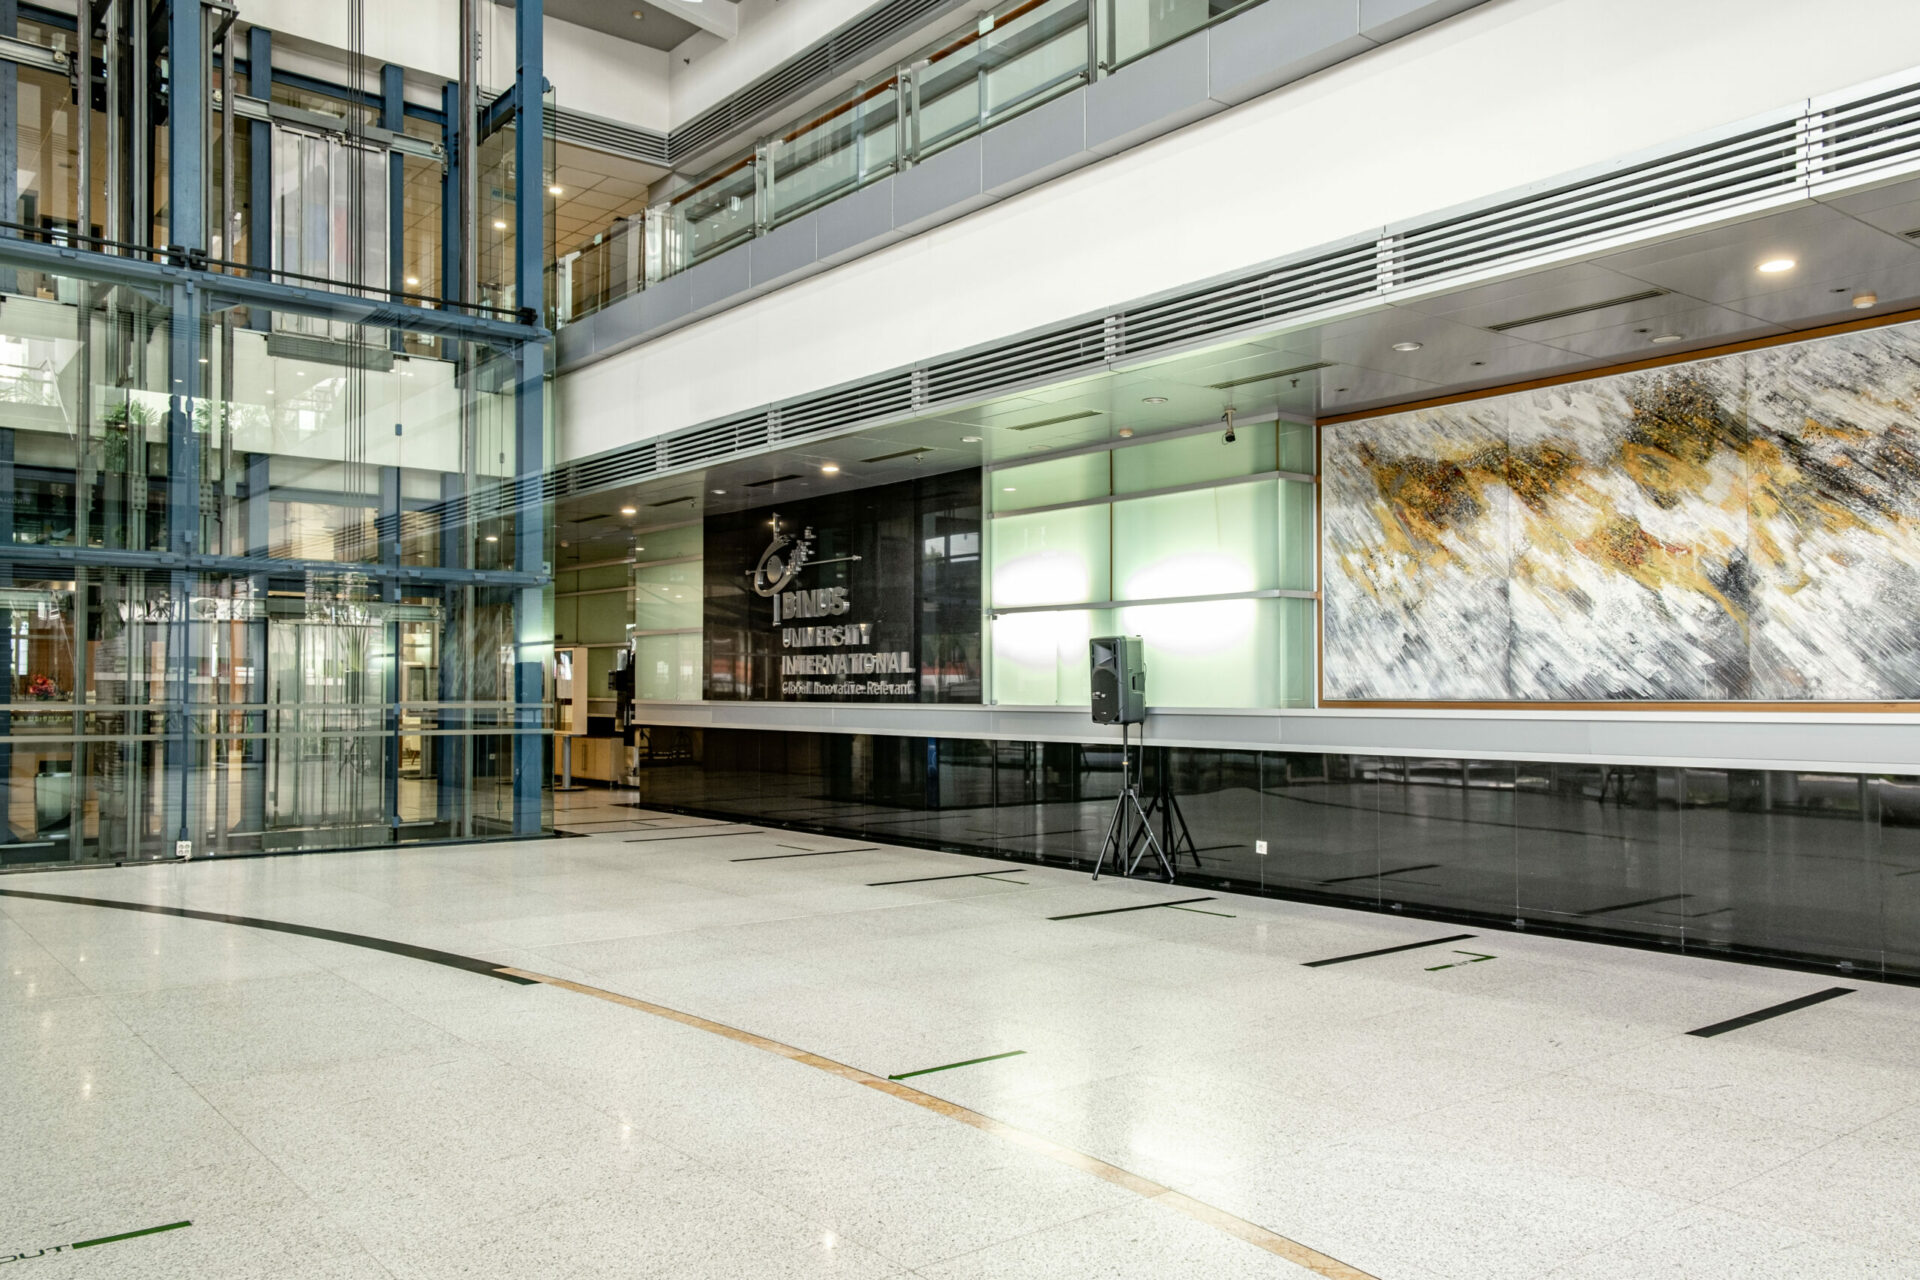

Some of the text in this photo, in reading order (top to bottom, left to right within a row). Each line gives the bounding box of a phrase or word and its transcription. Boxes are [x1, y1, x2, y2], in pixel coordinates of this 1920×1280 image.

[782, 586, 850, 619] BINUS
[782, 623, 873, 648] UNIVERSITY
[781, 652, 916, 675] INTERNATIONAL
